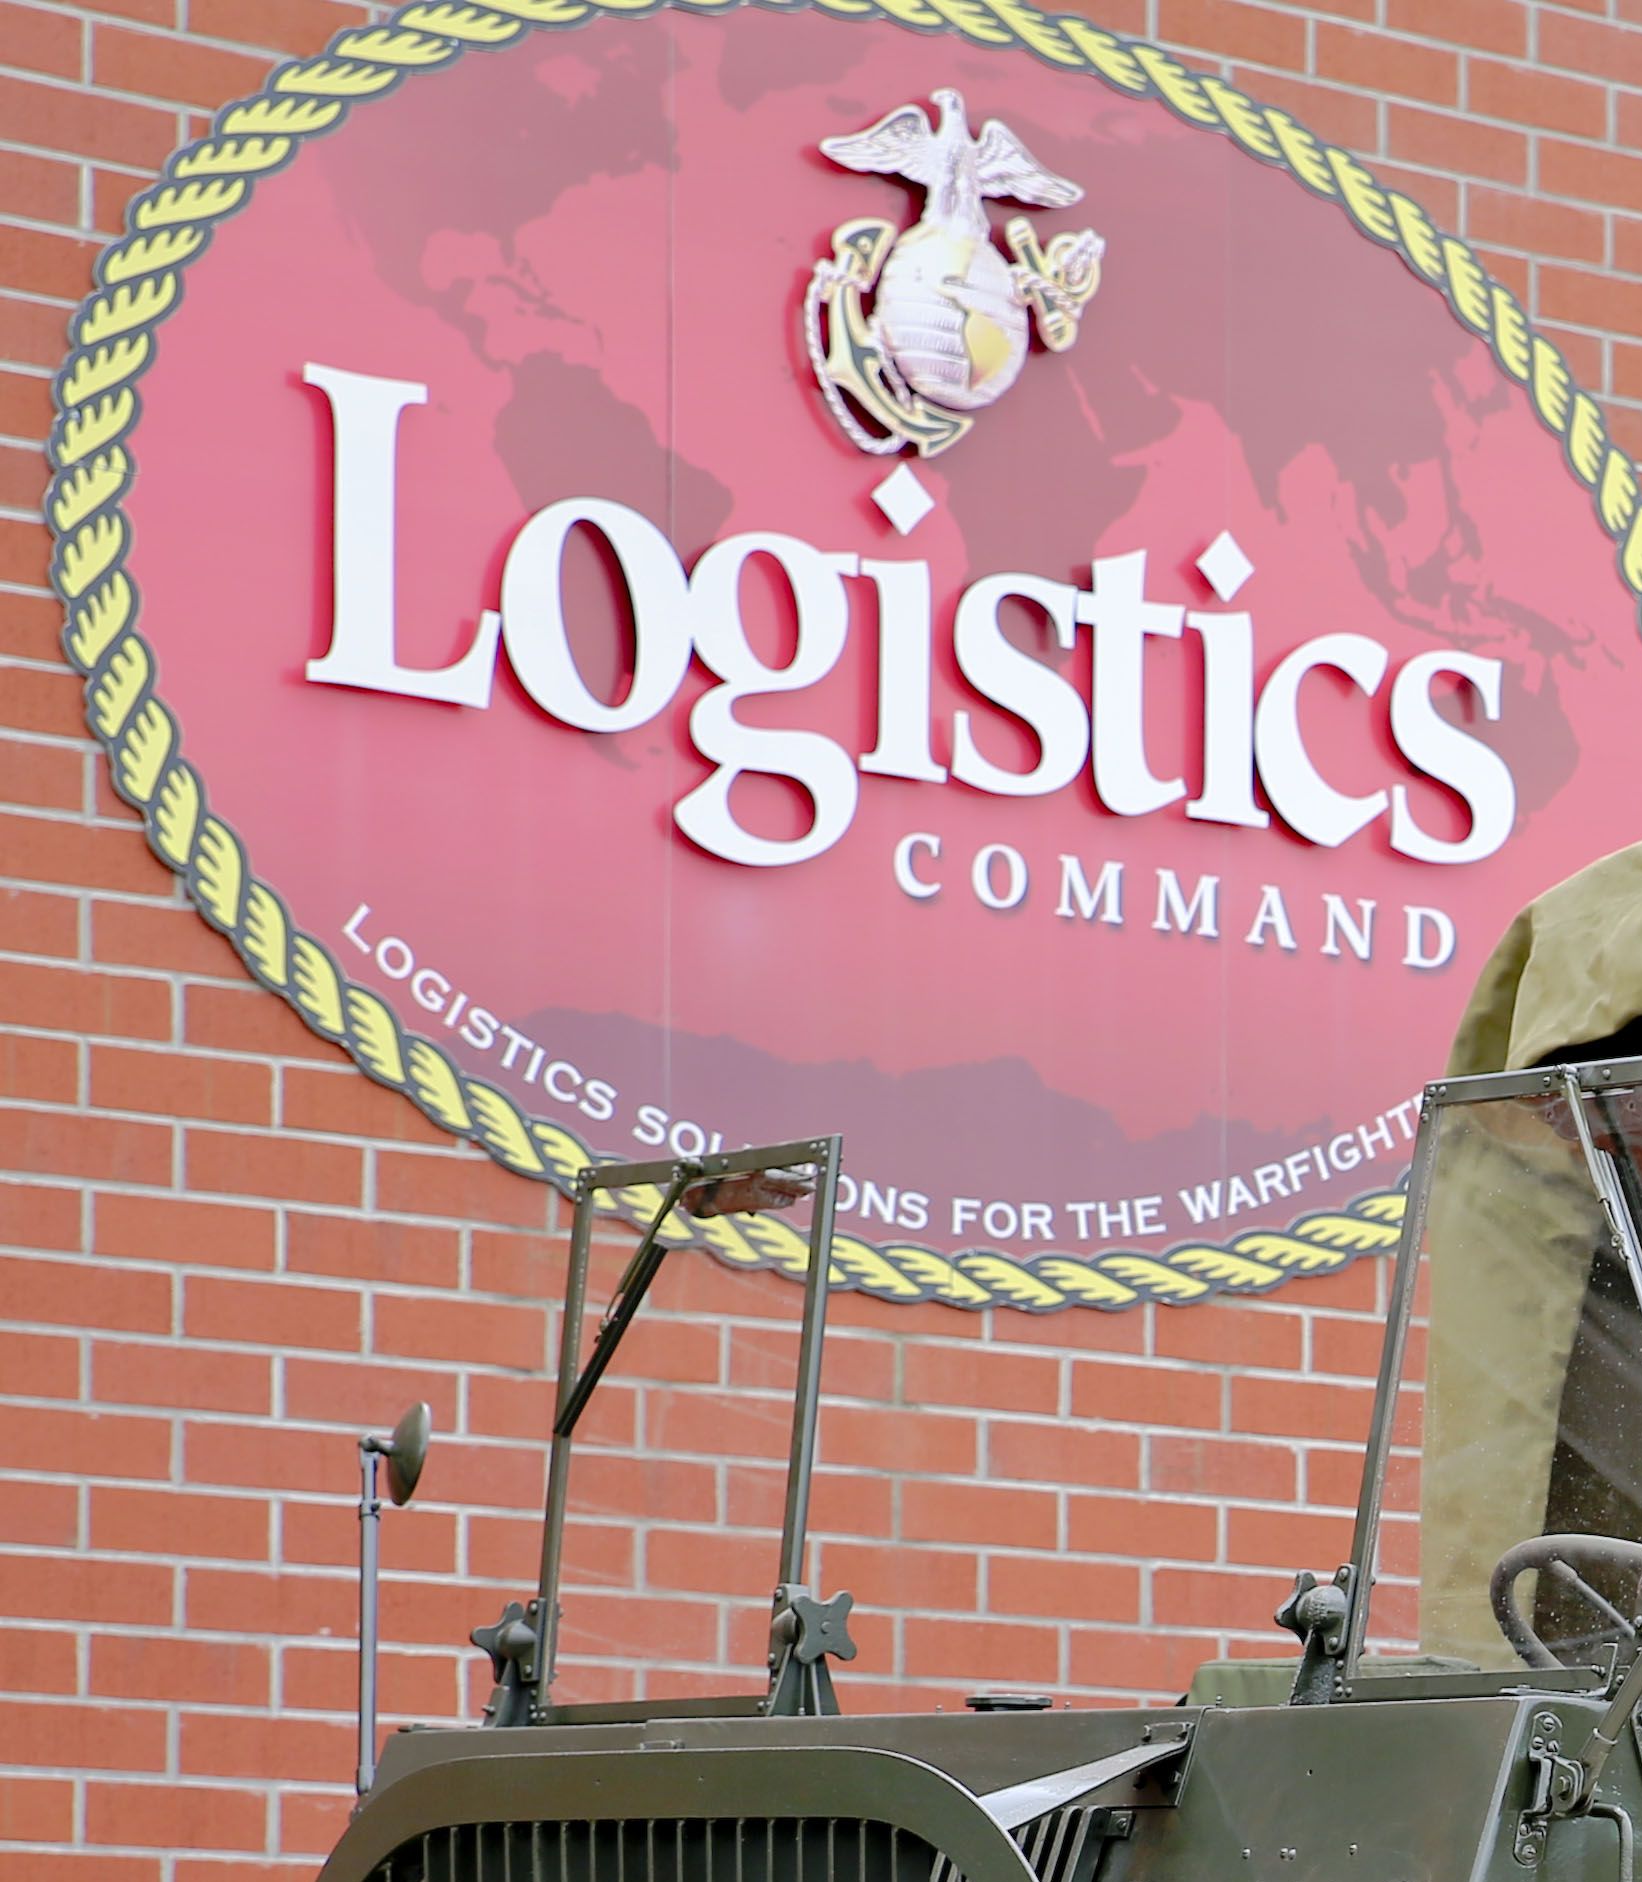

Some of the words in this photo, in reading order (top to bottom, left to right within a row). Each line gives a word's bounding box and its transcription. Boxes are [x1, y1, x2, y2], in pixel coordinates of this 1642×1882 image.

[303, 364, 1518, 868] Logistics
[893, 832, 1457, 969] COMMAND
[342, 902, 618, 1121] LOGISTICS
[632, 1104, 929, 1231] SOONS
[951, 1198, 1055, 1241] FOR
[1066, 1195, 1166, 1241] THE
[1179, 1091, 1424, 1225] WARFIGHT
